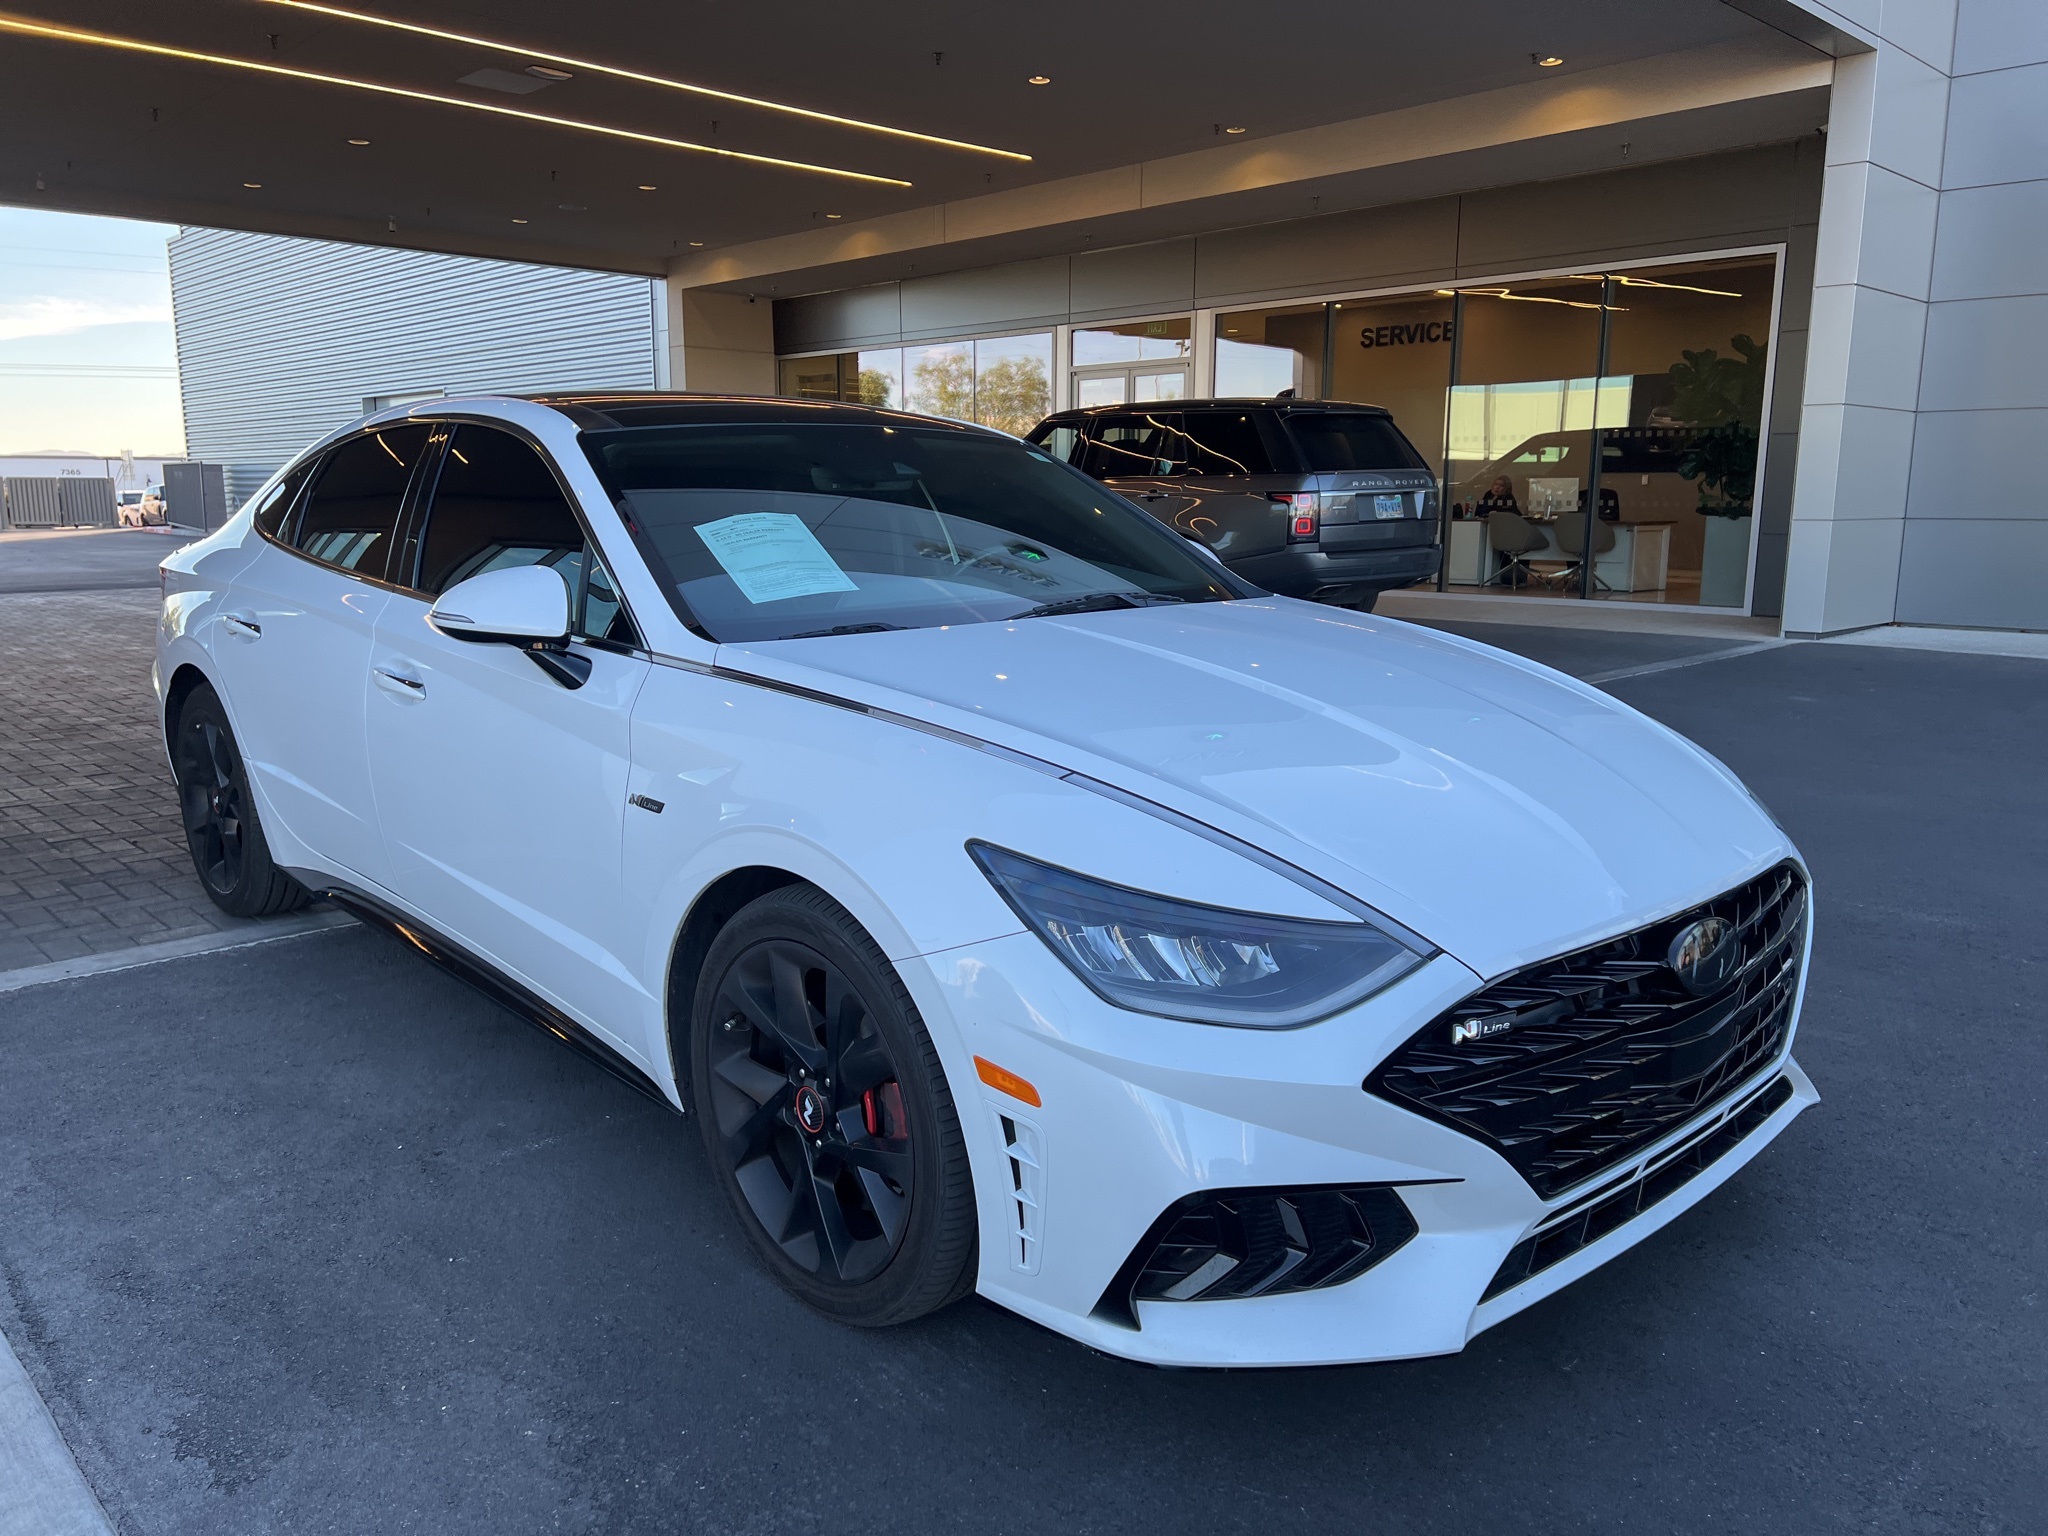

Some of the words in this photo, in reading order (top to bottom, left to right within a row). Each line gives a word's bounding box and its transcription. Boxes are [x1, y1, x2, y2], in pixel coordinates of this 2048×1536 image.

[1360, 321, 1453, 349] SERVICE
[60, 468, 81, 476] 7365
[1483, 1021, 1511, 1034] Line
